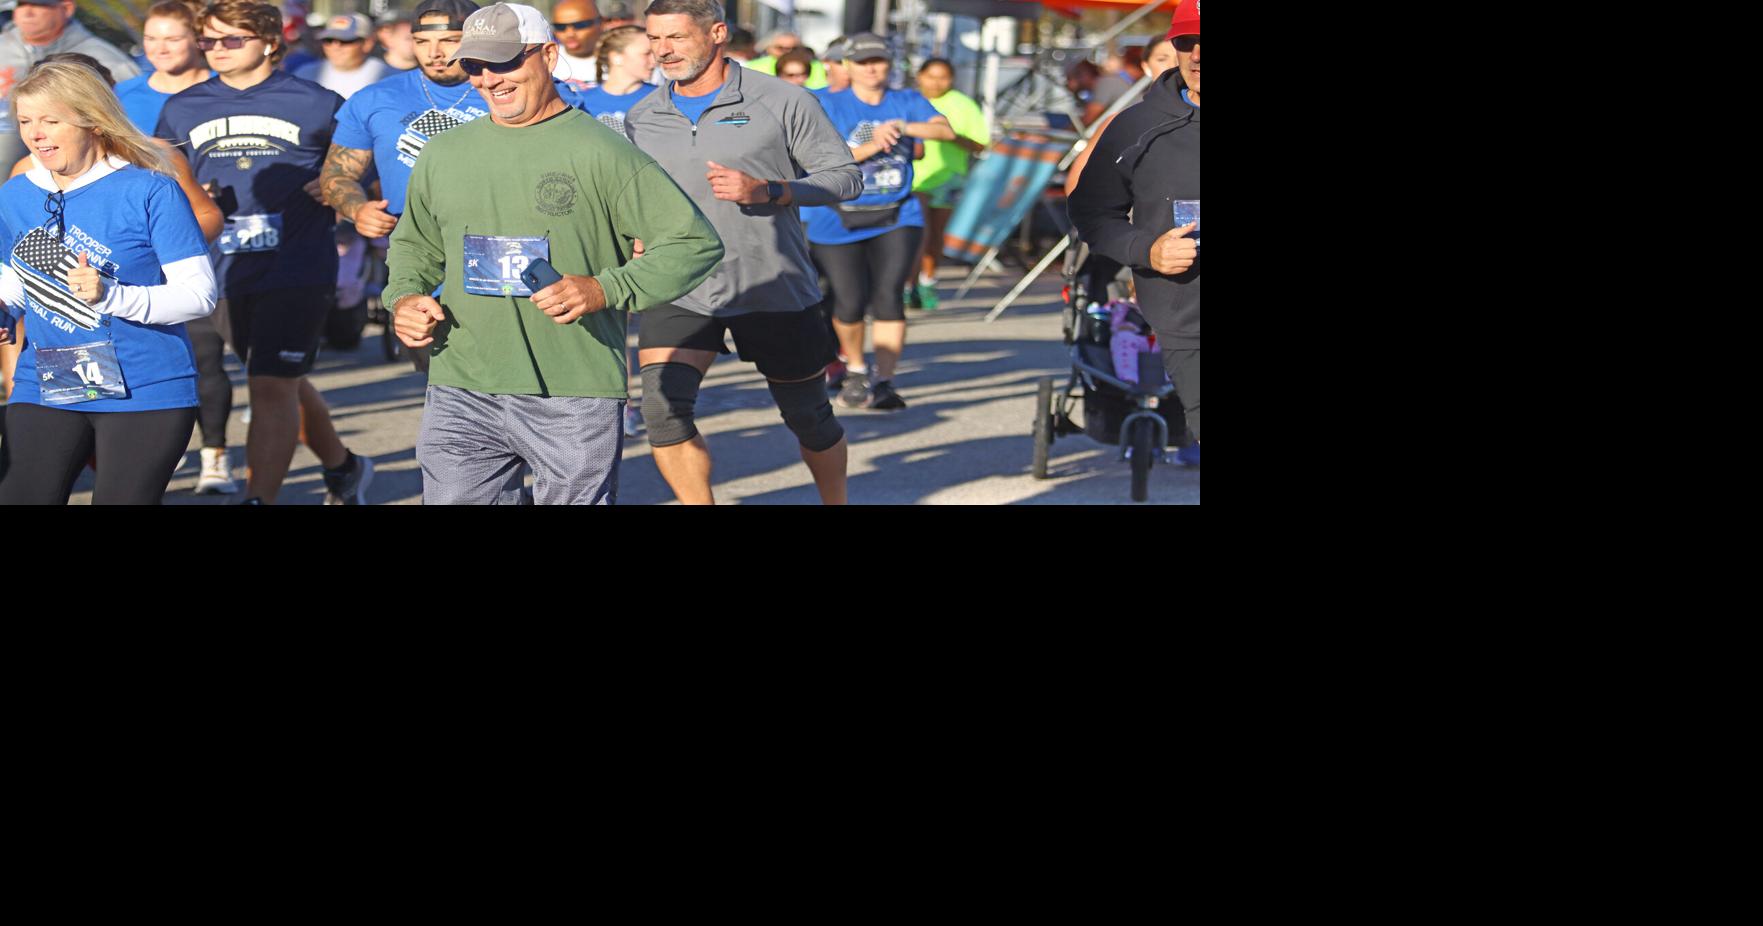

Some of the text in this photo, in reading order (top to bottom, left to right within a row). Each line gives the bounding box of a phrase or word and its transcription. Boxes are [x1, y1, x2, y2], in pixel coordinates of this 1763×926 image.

[69, 224, 112, 257] TROOPER
[467, 259, 479, 268] 5K
[498, 255, 529, 279] 13
[50, 315, 76, 333] RUN
[42, 371, 54, 381] 5K
[72, 361, 104, 385] 14
